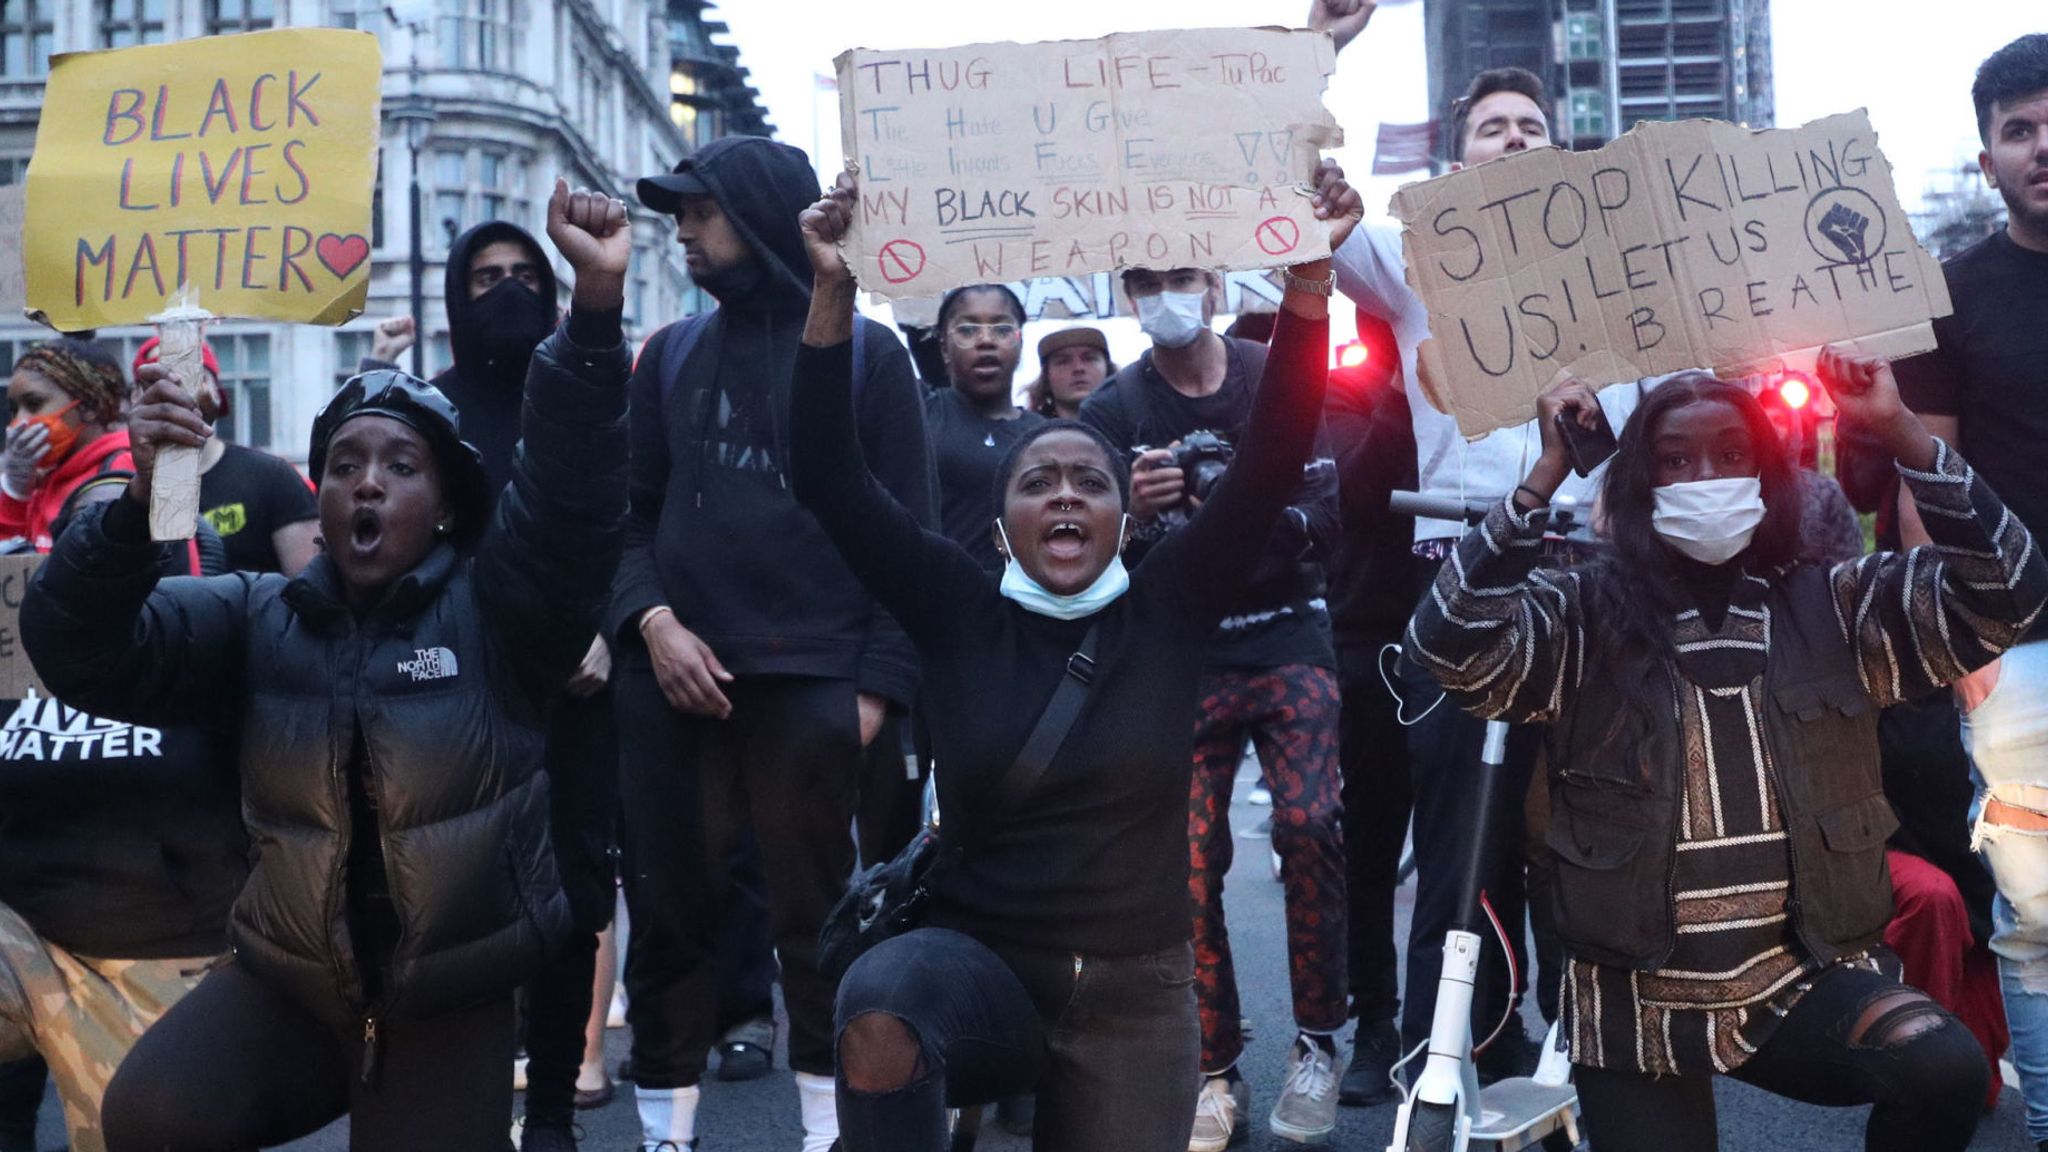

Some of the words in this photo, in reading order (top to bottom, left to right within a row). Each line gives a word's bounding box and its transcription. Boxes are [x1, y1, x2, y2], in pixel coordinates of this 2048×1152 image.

[857, 57, 993, 95] THUG
[1064, 56, 1182, 89] LIFE
[102, 70, 322, 147] BLACK
[1033, 102, 1057, 135] U
[118, 140, 310, 211] LIVES
[863, 187, 909, 227] MY
[934, 188, 1036, 227] BLACK
[1053, 185, 1128, 220] SKIN
[1147, 186, 1174, 213] IS
[1188, 185, 1234, 211] NOT
[1259, 186, 1279, 211] A
[1433, 167, 1632, 281] STOP
[1665, 139, 1872, 222] KILLING
[75, 226, 316, 308] MATTER
[973, 231, 1213, 278] WEAPON
[1460, 278, 1587, 376] US!
[1585, 236, 1690, 299] LET
[1706, 219, 1767, 265] US
[1625, 250, 1914, 352] BREATHE
[397, 658, 440, 673] NORTH
[411, 669, 442, 682] FACE
[414, 647, 440, 661] THE
